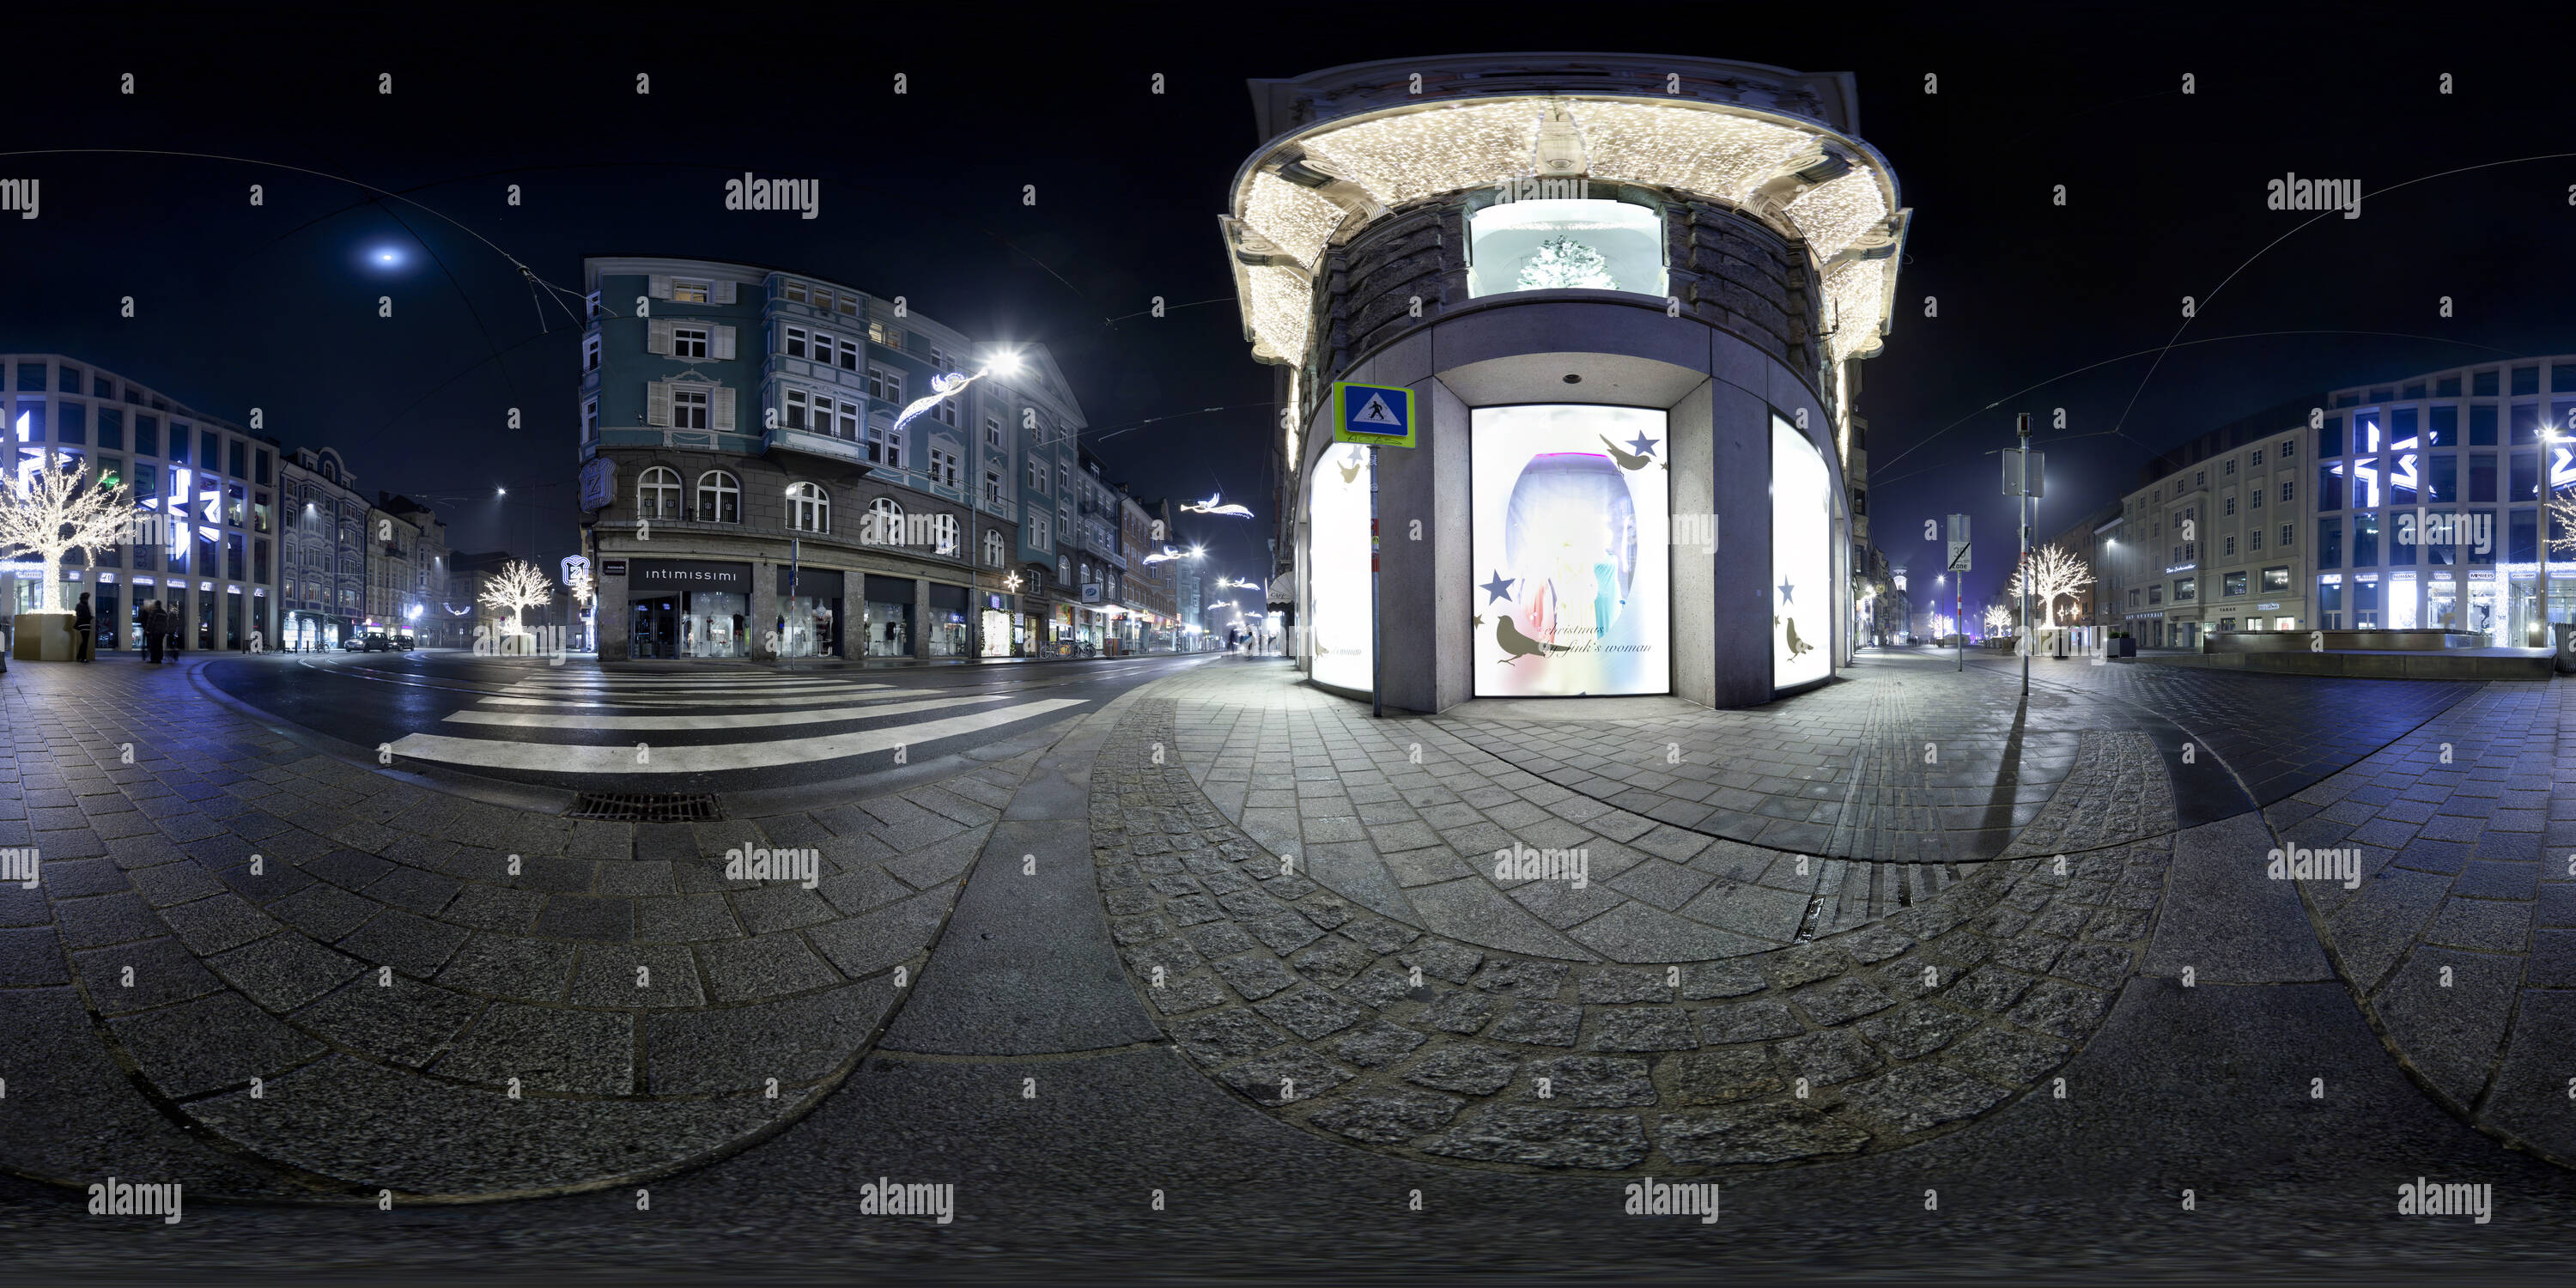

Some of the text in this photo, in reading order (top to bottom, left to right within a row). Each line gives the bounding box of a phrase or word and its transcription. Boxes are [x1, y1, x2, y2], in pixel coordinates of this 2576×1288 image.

[646, 568, 737, 581] intimissimi
[1545, 623, 1604, 635] christmas
[1605, 644, 1652, 653] woman
